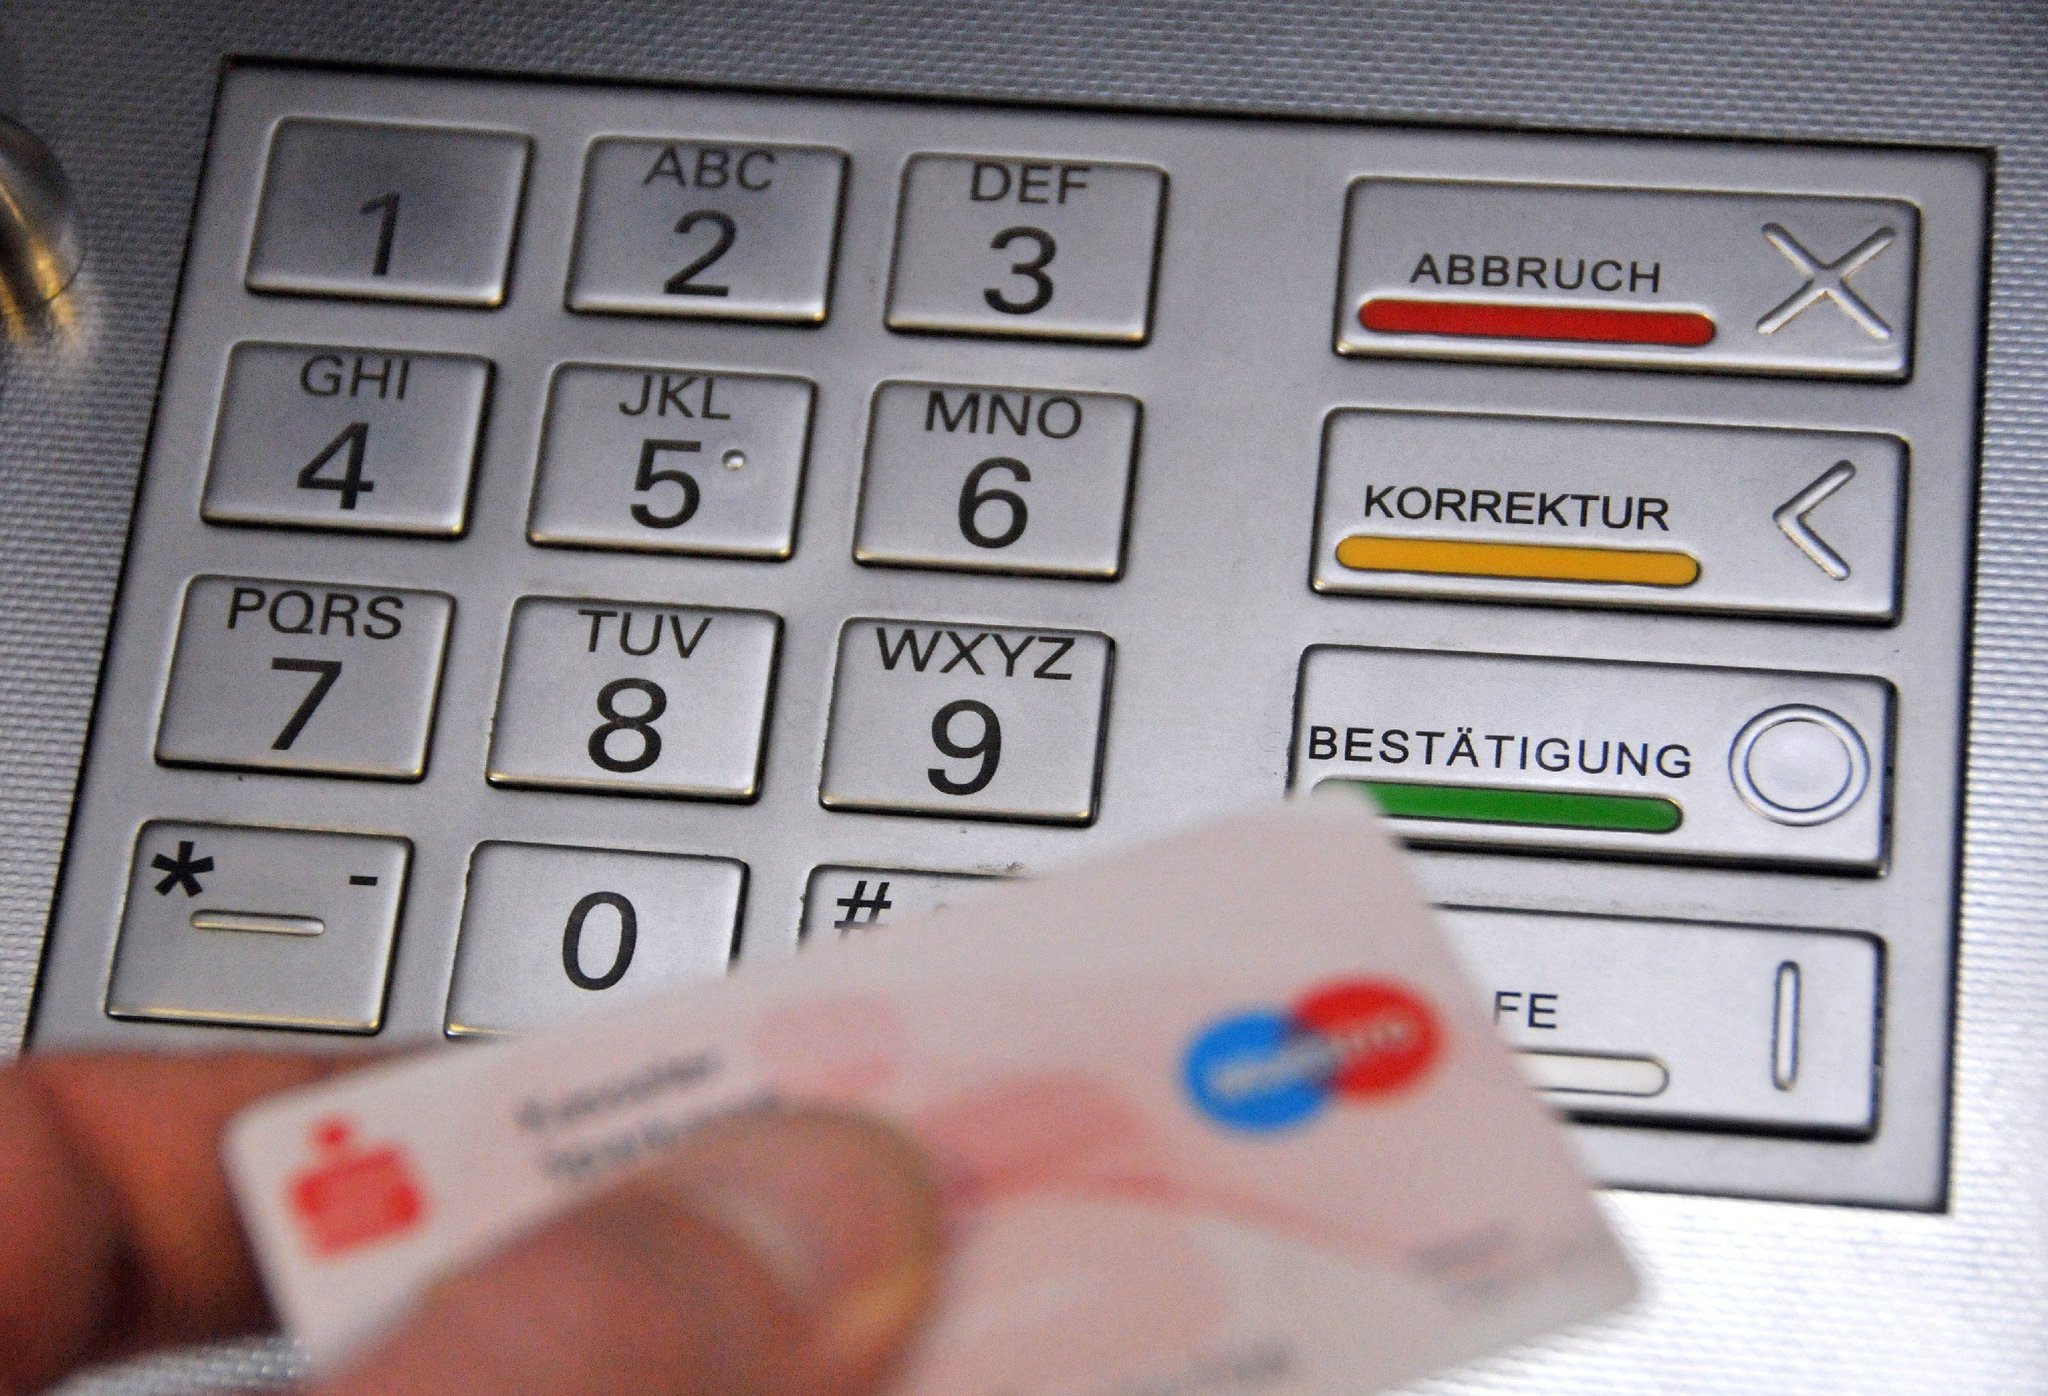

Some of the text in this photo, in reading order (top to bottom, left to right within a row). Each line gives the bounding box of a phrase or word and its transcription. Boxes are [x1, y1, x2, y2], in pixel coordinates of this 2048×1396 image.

[643, 147, 777, 191] ABC
[970, 164, 1091, 205] DEF
[359, 191, 399, 276] 1
[665, 210, 736, 296] 2
[984, 227, 1056, 315] 3
[1411, 254, 1660, 293] ABBRUCH
[299, 354, 411, 401] GHI
[618, 375, 731, 421] JKL
[925, 390, 1083, 440] MNO
[298, 423, 373, 509] 4
[632, 439, 701, 529] 5
[959, 458, 1030, 548] 6
[1365, 486, 1668, 530] KORREKTUR
[227, 587, 404, 640] PQRS
[577, 609, 712, 659] TUV
[875, 626, 1075, 681] WXYZ
[272, 658, 342, 750] 7
[588, 678, 667, 773] 8
[928, 700, 1001, 795] 9
[1307, 725, 1692, 780] BESTÄTIGUNG
[833, 880, 892, 935] #
[563, 892, 637, 990] 0
